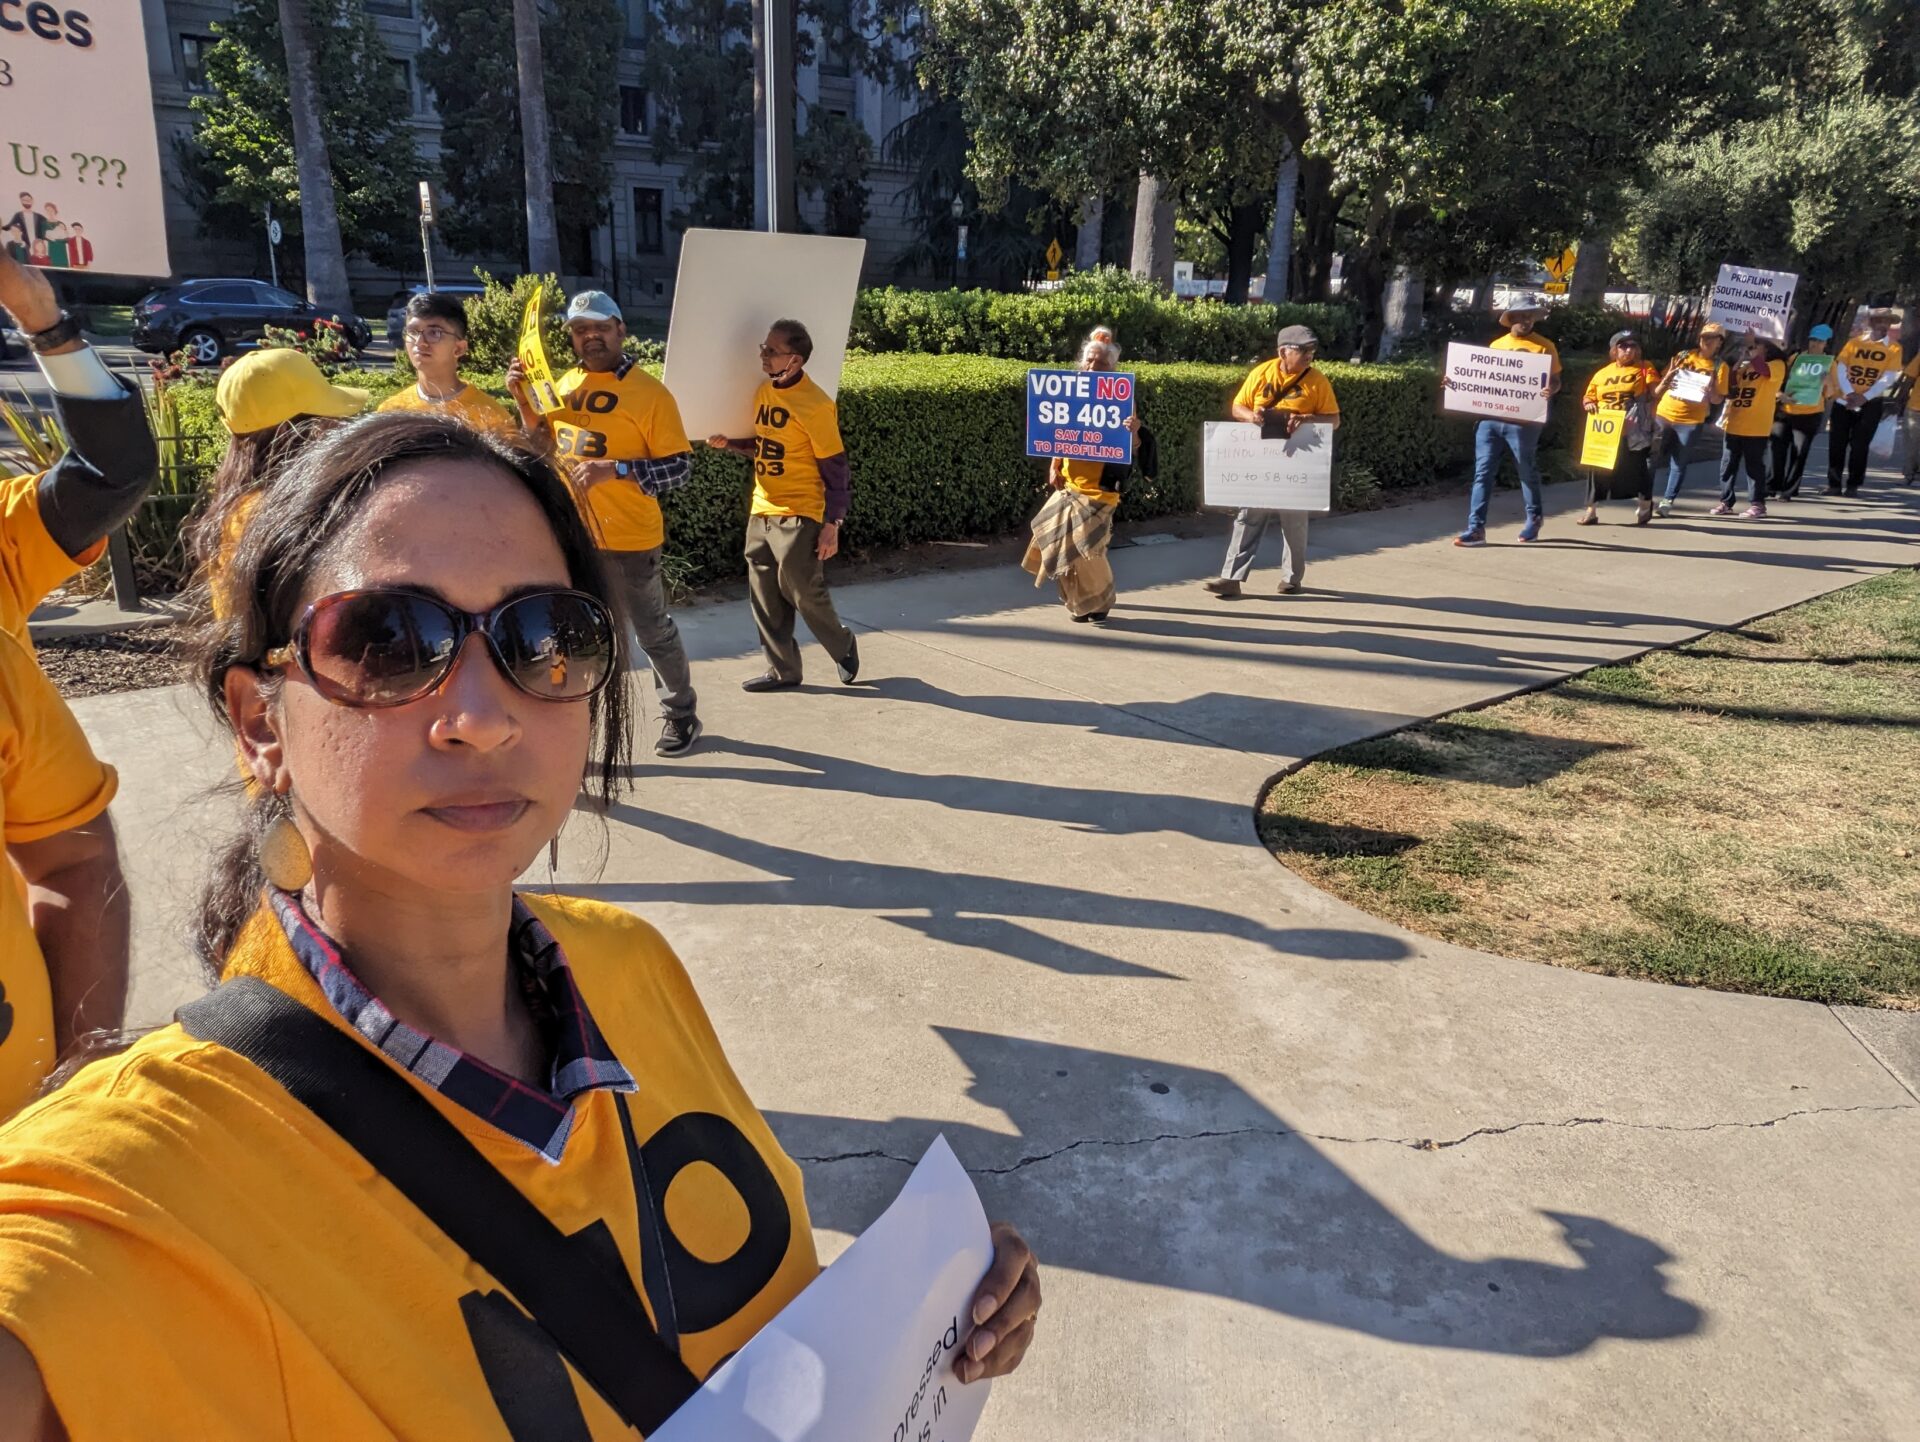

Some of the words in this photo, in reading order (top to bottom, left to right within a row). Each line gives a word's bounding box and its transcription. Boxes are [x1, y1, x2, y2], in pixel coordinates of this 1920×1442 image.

[8, 142, 61, 179] Us
[71, 152, 128, 189] ???
[1731, 273, 1773, 287] PROFILING
[1716, 285, 1742, 297] SOUTH
[1742, 289, 1773, 303] ASIANS
[1774, 294, 1783, 304] IS
[1712, 299, 1779, 318] DISCRIMINATORY
[1725, 317, 1734, 325] NO
[1734, 318, 1742, 326] TO
[1470, 354, 1523, 369] PROFILING
[1855, 349, 1886, 362] NO
[533, 369, 545, 380] 403
[1454, 366, 1487, 379] SOUTH
[1488, 371, 1527, 385] ASIANS
[1528, 376, 1539, 386] IS
[1799, 362, 1824, 376] NO
[1850, 365, 1879, 379] SB
[1031, 374, 1091, 398] VOTE
[1096, 377, 1132, 401] NO
[1605, 374, 1636, 386] NO
[1451, 381, 1537, 401] DISCRIMINATORY
[564, 389, 619, 414] NO
[1472, 400, 1482, 408] NO
[1483, 401, 1493, 409] TO
[1494, 402, 1505, 411] SB
[1505, 404, 1520, 413] 403
[755, 404, 790, 429] NO
[1038, 401, 1070, 425] SB
[1077, 403, 1121, 429] 403
[1592, 419, 1615, 434] NO
[557, 427, 608, 458] SB
[1055, 428, 1081, 441] SAY
[1082, 431, 1103, 443] NO
[1230, 428, 1261, 442] STO
[754, 435, 785, 460] SB
[1034, 440, 1052, 452] TO
[1055, 442, 1124, 459] PROFILING
[756, 461, 785, 476] 03
[1222, 473, 1239, 484] NO
[1244, 472, 1258, 481] to
[1264, 472, 1280, 482] SB
[1286, 473, 1308, 484] 403
[932, 1385, 947, 1422] in
